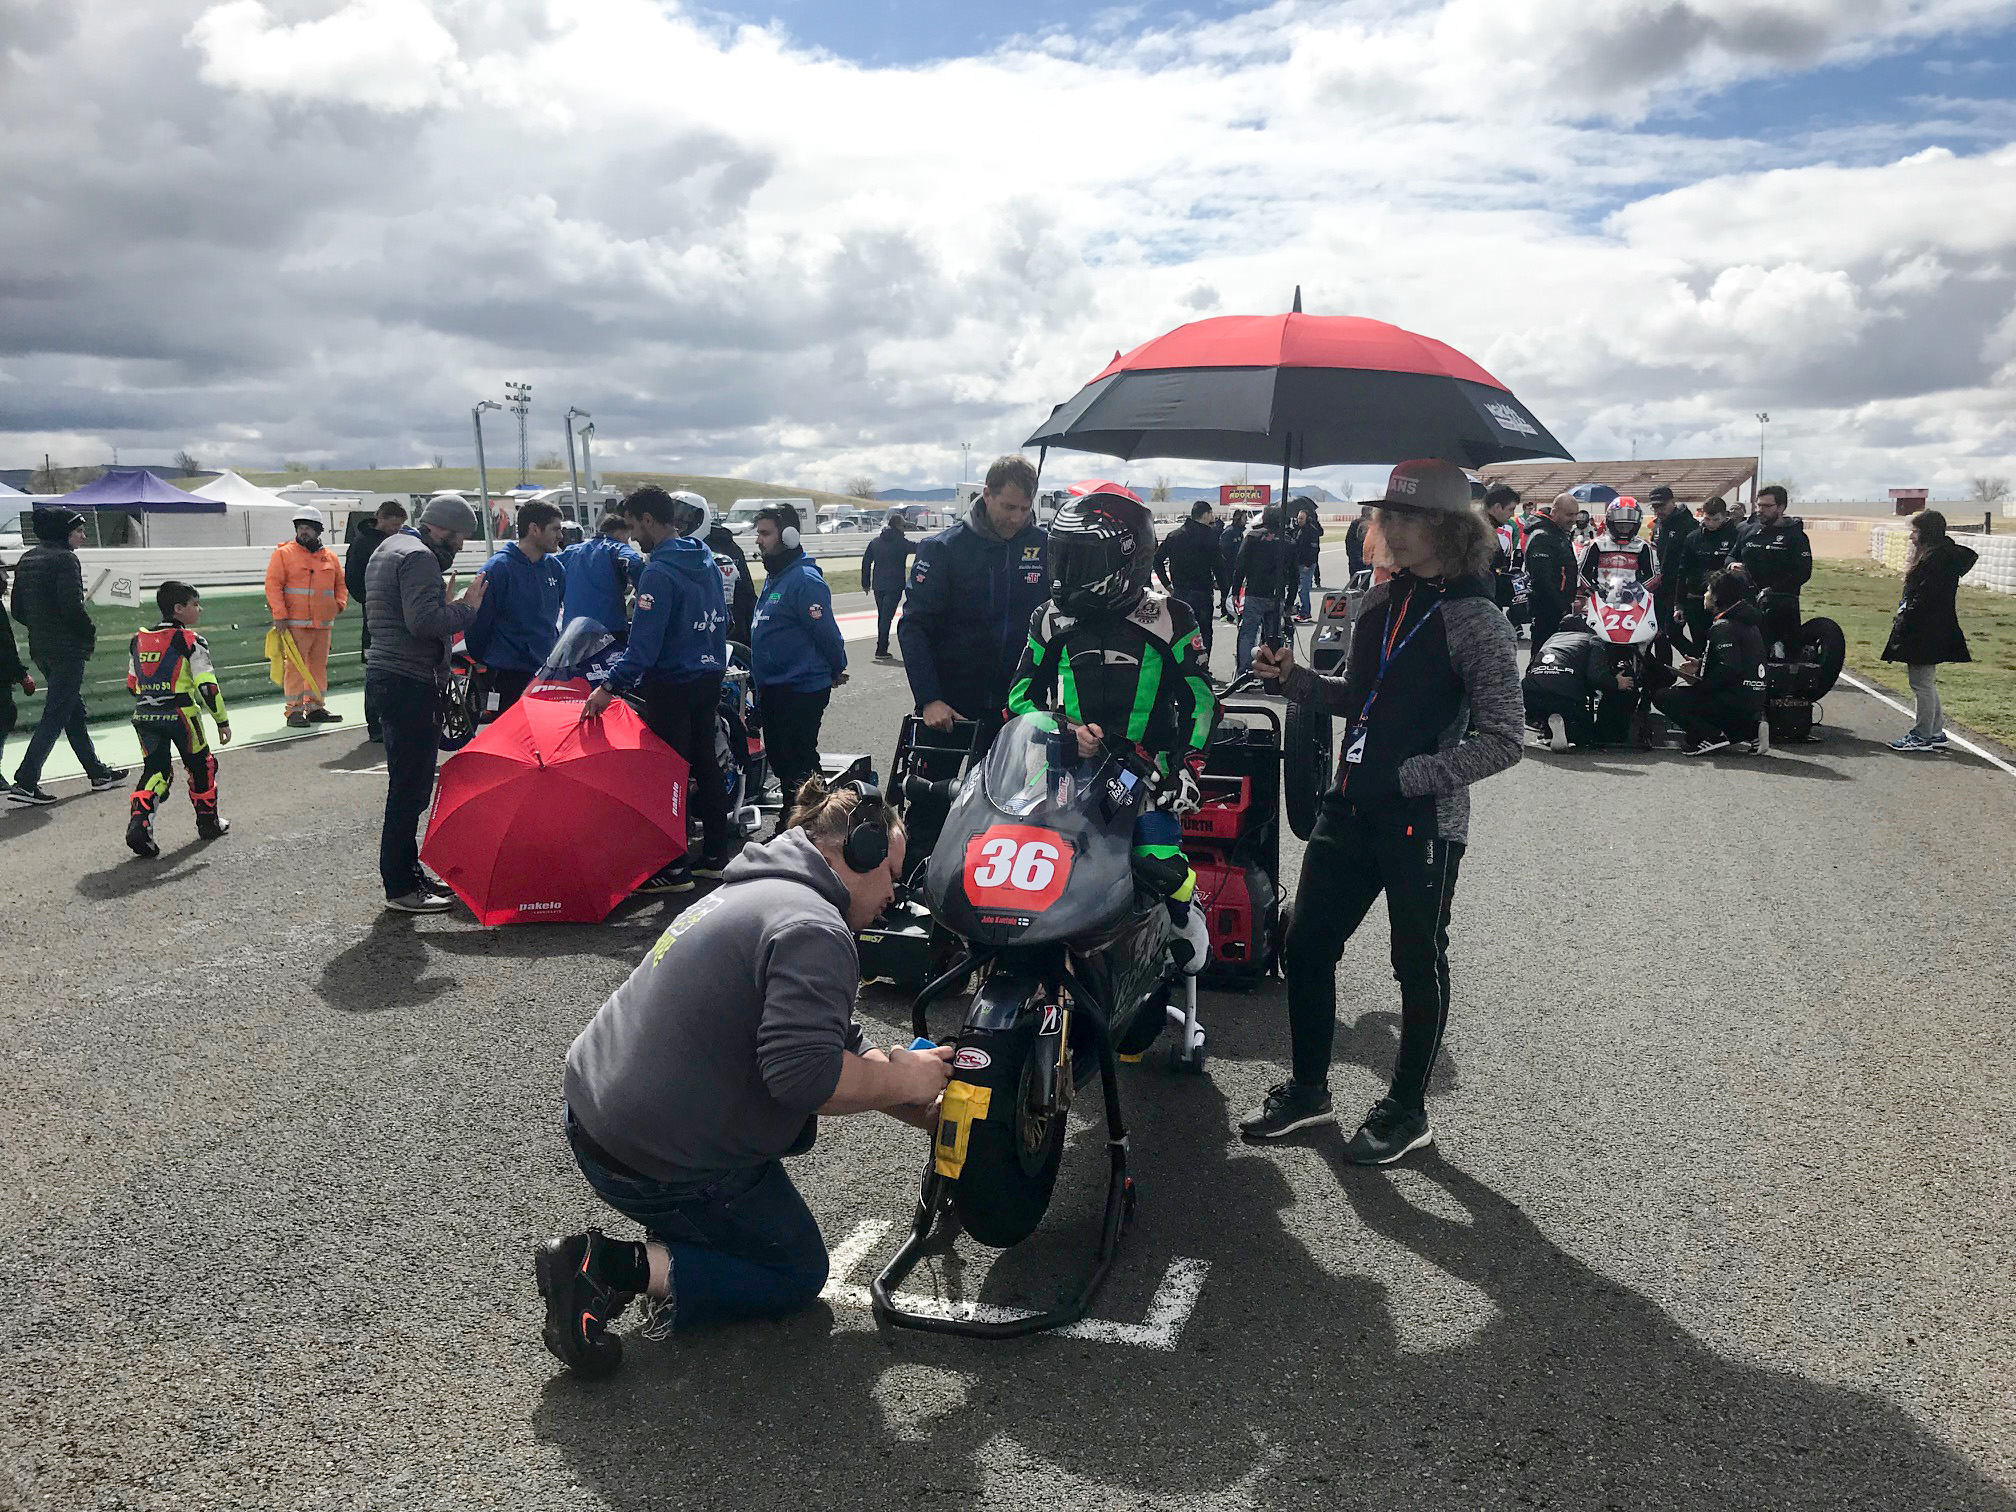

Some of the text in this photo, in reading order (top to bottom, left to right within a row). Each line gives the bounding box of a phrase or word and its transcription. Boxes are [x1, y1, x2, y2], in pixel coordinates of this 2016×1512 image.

[1605, 614, 1637, 630] 26
[139, 651, 161, 663] 50
[671, 781, 679, 817] pakelo
[973, 837, 1060, 891] 36
[519, 901, 562, 912] pakelo
